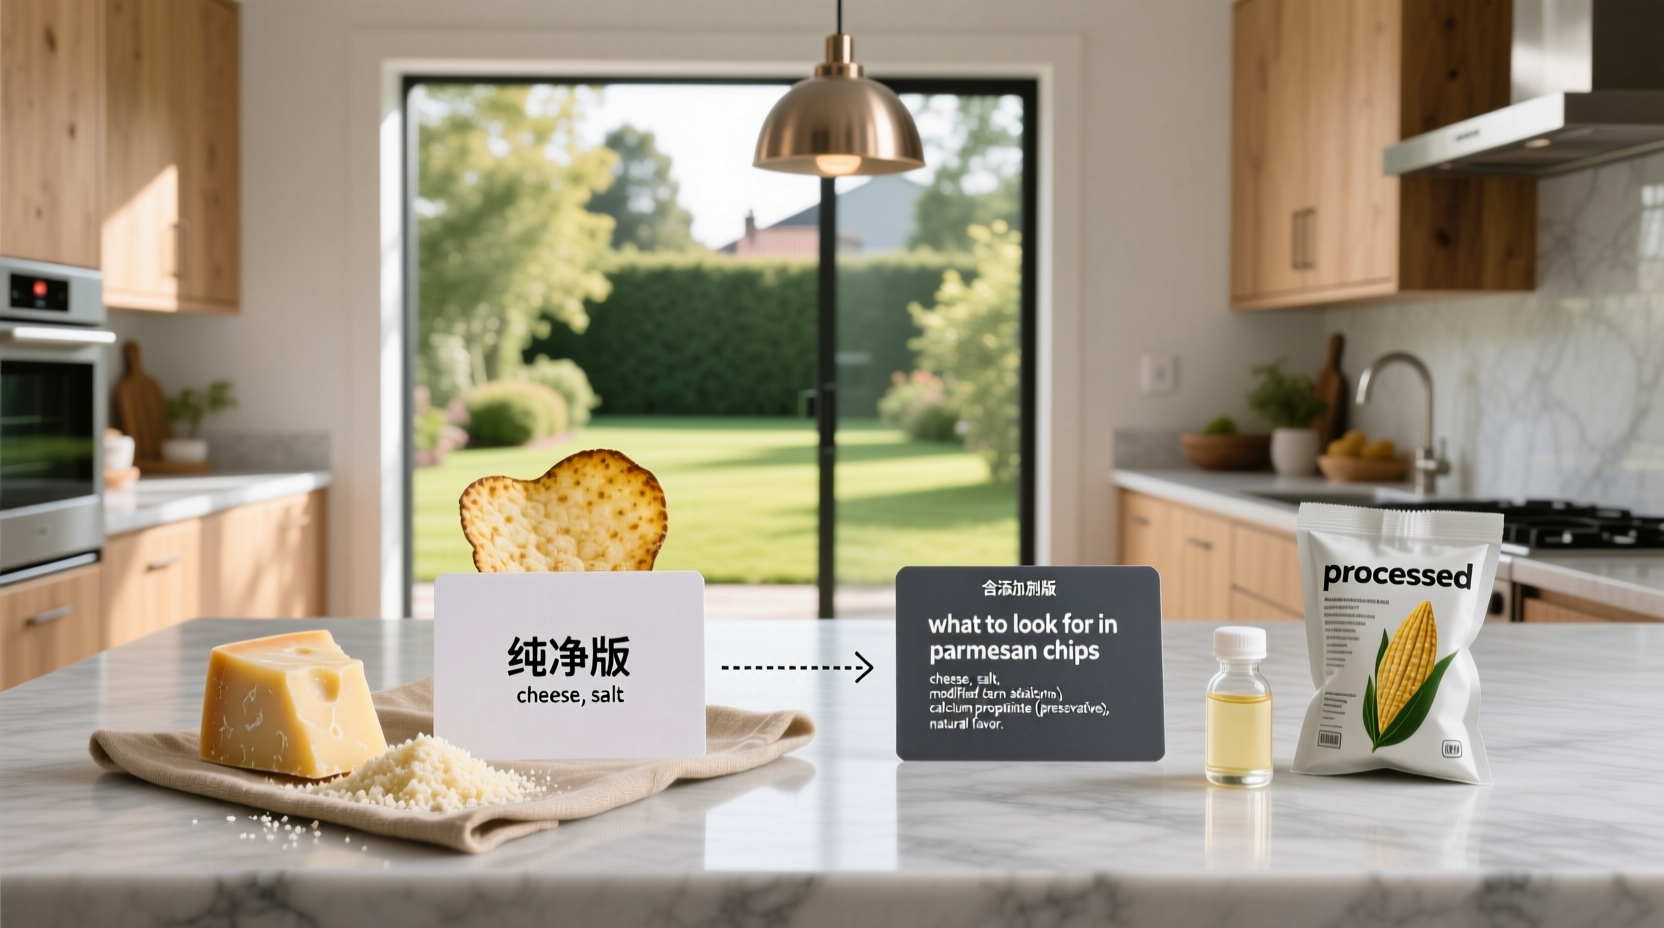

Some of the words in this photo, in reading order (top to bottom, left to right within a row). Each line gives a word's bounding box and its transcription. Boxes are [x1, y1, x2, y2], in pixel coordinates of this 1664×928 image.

[1323, 563, 1474, 592] processed
[928, 613, 981, 634] what
[985, 615, 1008, 634] to
[1013, 613, 1058, 634] look
[1062, 613, 1094, 634] for
[1098, 613, 1118, 634] in
[507, 635, 631, 678] 纯净版
[930, 644, 1037, 665] parmesan
[1043, 639, 1100, 665] chips
[929, 671, 973, 686] cheese,
[517, 686, 586, 707] cheese,
[591, 685, 625, 703] salt
[929, 717, 969, 730] natural
